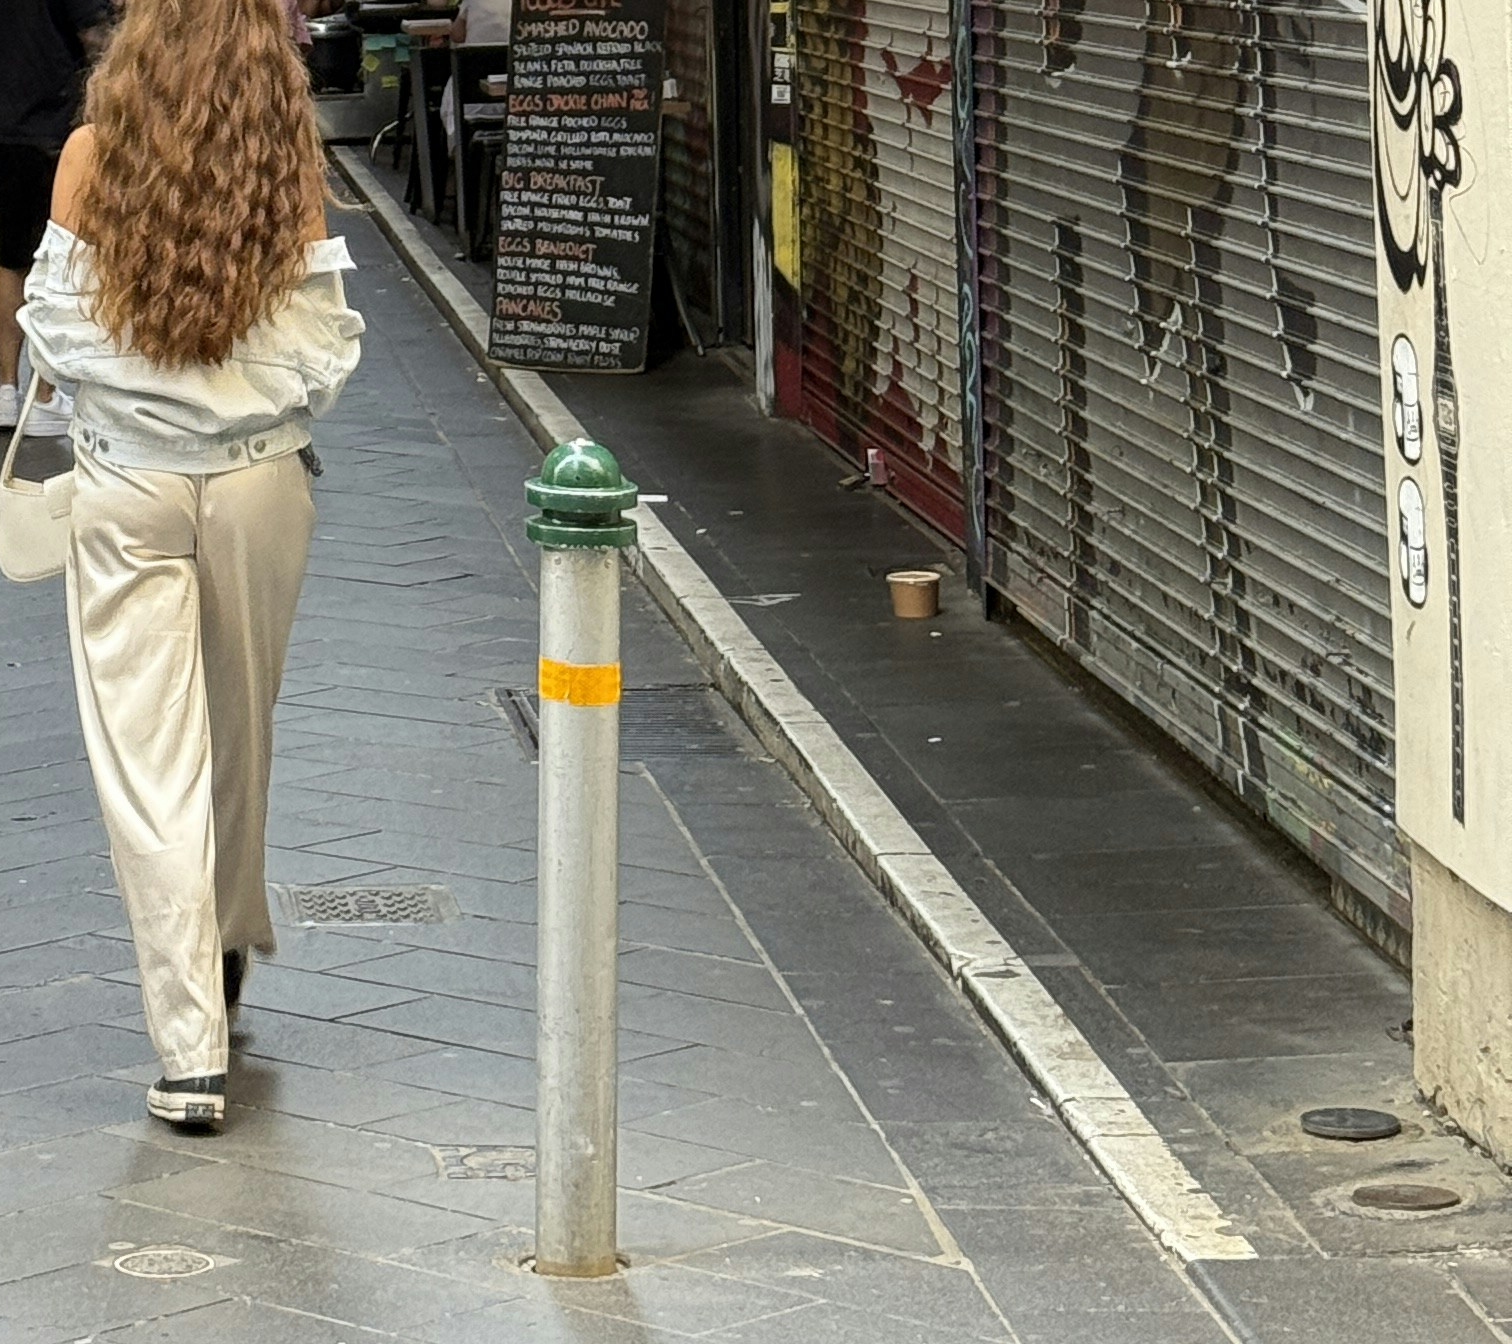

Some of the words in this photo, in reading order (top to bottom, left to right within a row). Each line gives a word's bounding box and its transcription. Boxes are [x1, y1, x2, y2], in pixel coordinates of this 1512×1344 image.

[515, 18, 580, 40] SMASHED
[583, 19, 648, 39] AVOCADO
[508, 94, 543, 113] EGGS
[546, 93, 587, 111] JACKIE
[590, 91, 627, 109] CHAN
[600, 116, 627, 128] EGGS
[501, 170, 523, 189] BIG
[529, 171, 605, 195] BREAKFAST
[498, 236, 530, 254] EGGS
[534, 239, 597, 258] BENEDICT
[495, 297, 561, 320] PANCAKES
